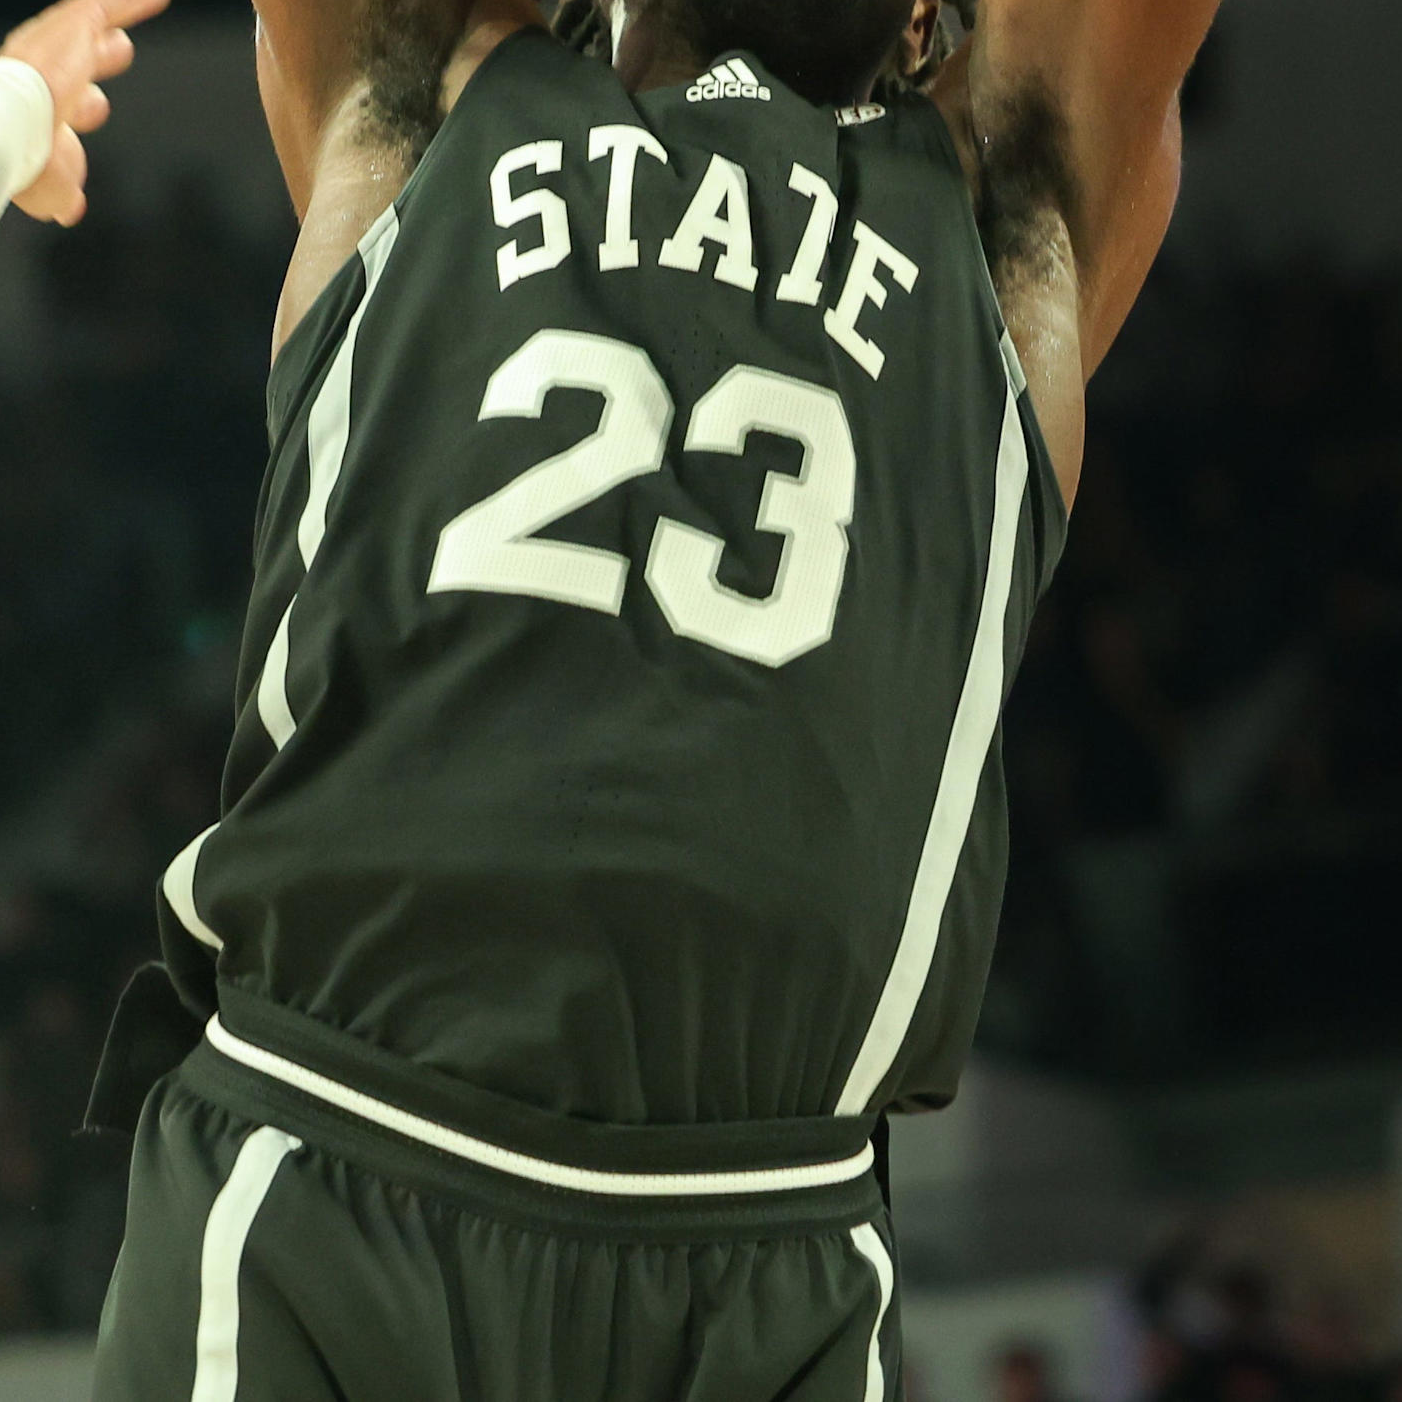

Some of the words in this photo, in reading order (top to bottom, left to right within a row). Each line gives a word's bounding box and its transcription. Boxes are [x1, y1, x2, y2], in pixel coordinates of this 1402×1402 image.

[685, 79, 772, 103] adidas
[489, 124, 919, 381] STATE
[426, 328, 857, 668] 23
